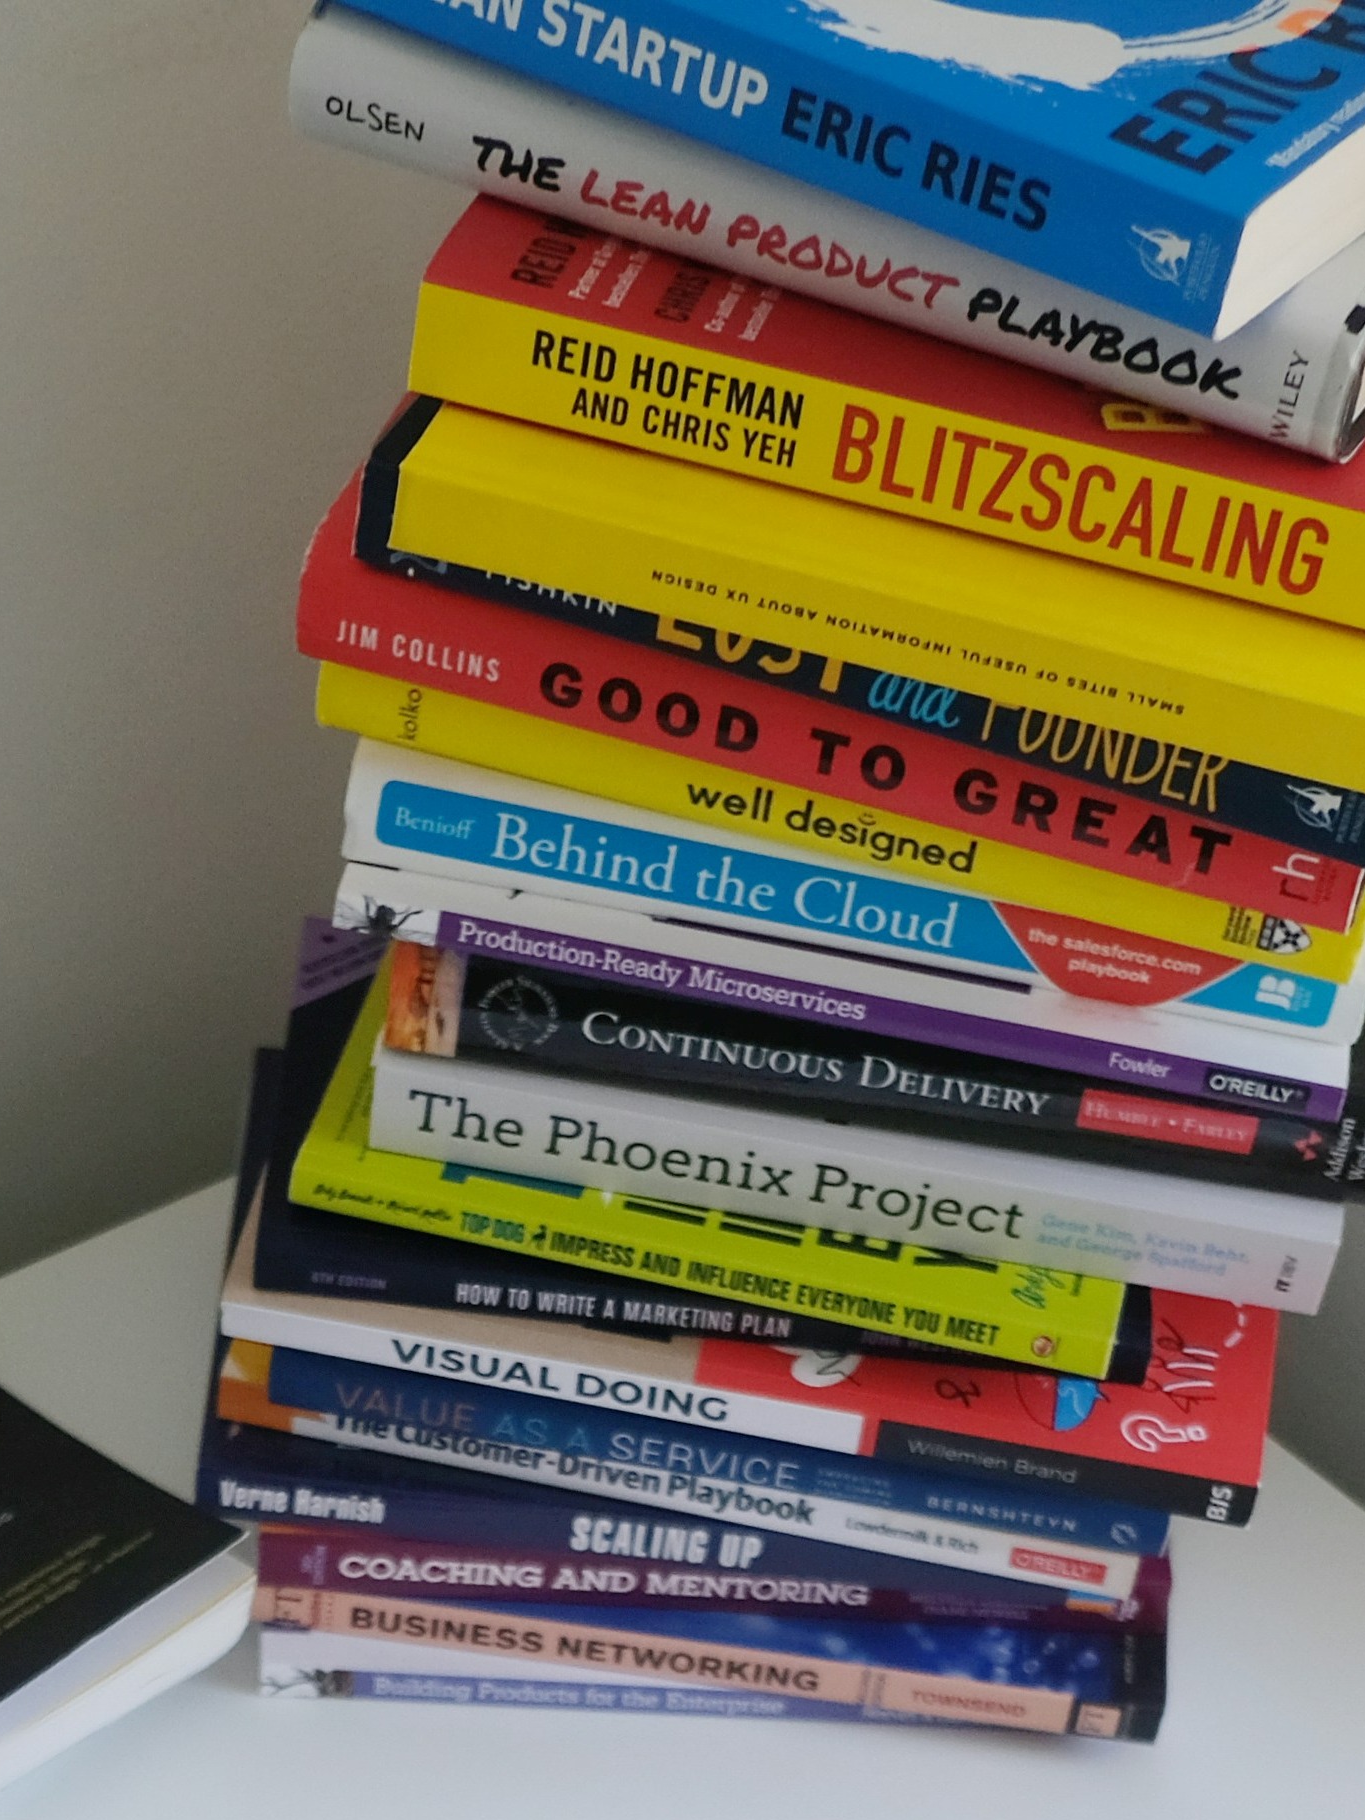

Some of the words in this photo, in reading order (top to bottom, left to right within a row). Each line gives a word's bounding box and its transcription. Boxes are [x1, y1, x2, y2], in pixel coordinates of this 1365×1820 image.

[538, 0, 769, 117] STARTUP
[781, 86, 913, 178] ERIC
[922, 138, 1050, 233] RIES
[1110, 46, 1341, 176] ERIC
[326, 96, 425, 142] OLSEN
[472, 135, 567, 193] THE
[581, 168, 711, 236] LEAN
[727, 213, 961, 310] PRODUCT
[968, 287, 1241, 402] PLAYBOOK
[1268, 349, 1311, 441] WILEY
[532, 329, 616, 383] REID
[630, 353, 804, 429] HOFFMAN
[572, 388, 629, 427] AND
[643, 404, 731, 452] CHRIS
[743, 429, 797, 468] YEH
[832, 403, 1330, 596] BLITZSCALING
[652, 569, 718, 596] DESIGN
[725, 589, 750, 605] UX
[757, 595, 818, 621] ABOUT
[825, 614, 952, 656] INFORMATION
[961, 647, 1028, 677] USEFUL
[1036, 669, 1060, 684] OF
[1066, 676, 1118, 699] BITES
[1129, 691, 1186, 716] SMALL
[336, 619, 378, 652] JIM
[391, 634, 501, 683] COLLINS
[539, 662, 759, 753] GOOD
[810, 728, 906, 792] TO
[952, 768, 1232, 876] GREAT
[398, 688, 423, 742] kolko
[687, 783, 773, 824] well
[785, 800, 978, 876] designed
[394, 807, 476, 840] Benioff
[491, 813, 679, 893] Behind
[695, 856, 776, 912] the
[793, 871, 960, 949] Cloud
[1028, 927, 1059, 950] the
[1062, 932, 1202, 977] salesforce.com
[1067, 955, 1151, 987] playbook
[457, 920, 682, 991] Production-Ready
[688, 965, 867, 1022] Microservices
[1108, 1051, 1172, 1081] Fowler
[580, 1010, 845, 1083] CONTINUOUS
[858, 1054, 1051, 1116] DELIVERY
[408, 1089, 523, 1148] The
[546, 1115, 793, 1199] Phoenix
[809, 1163, 1024, 1241] Project
[1324, 1115, 1356, 1183] Addison
[455, 1282, 500, 1306] HOW
[507, 1287, 531, 1311] TO
[537, 1291, 595, 1318] WRITE
[601, 1298, 615, 1319] A
[624, 1300, 733, 1334] MARKETING
[741, 1313, 792, 1338] PLAN
[549, 1234, 636, 1268] IMPRESS
[640, 1251, 680, 1278] AND
[686, 1261, 791, 1303] INFLUENCE
[795, 1281, 898, 1319] EVERYONE
[902, 1304, 941, 1331] YOU
[945, 1314, 1001, 1347] MEET
[335, 1414, 390, 1440] The
[395, 1420, 661, 1497] Customer-Driven
[667, 1474, 816, 1528] Playbook
[336, 1384, 476, 1431] VALUE
[491, 1415, 548, 1447] AS
[565, 1426, 590, 1452] A
[607, 1431, 802, 1491] SERVICE
[391, 1338, 559, 1392] VISUAL
[574, 1371, 730, 1424] DOING
[1013, 1458, 1078, 1485] Brand
[1206, 1485, 1233, 1521] BIS
[218, 1479, 288, 1514] Verne
[294, 1487, 386, 1525] Harnish
[569, 1516, 712, 1565] SCALING
[719, 1534, 765, 1570] UP
[337, 1554, 544, 1590] COACHING
[552, 1567, 636, 1594] AND
[646, 1569, 870, 1606] MENTORING
[350, 1606, 544, 1654] BUSINESS
[557, 1626, 820, 1692] NETWORKING
